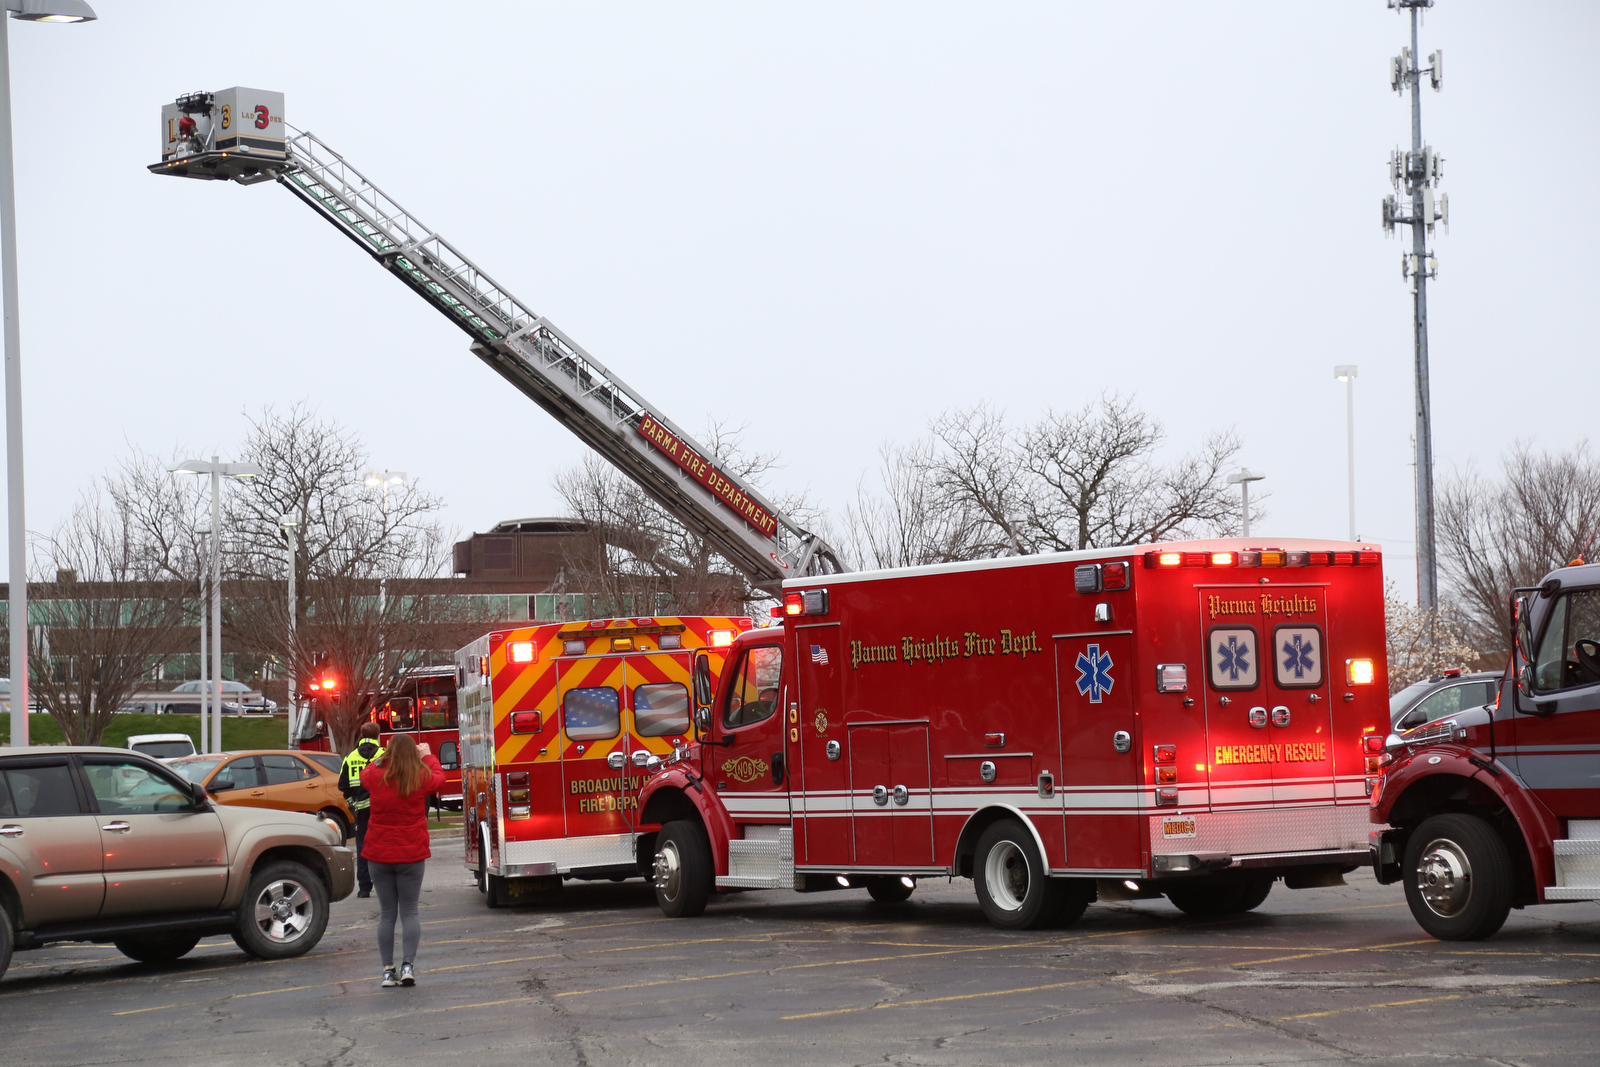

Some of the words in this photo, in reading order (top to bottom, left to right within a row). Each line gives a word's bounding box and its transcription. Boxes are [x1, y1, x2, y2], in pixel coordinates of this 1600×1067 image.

[221, 104, 231, 130] 3
[241, 111, 255, 120] LAD
[255, 104, 270, 130] 3
[269, 116, 283, 124] DER
[642, 418, 678, 456] PARMA
[680, 450, 707, 478] FIRE
[707, 472, 775, 533] DEPARTMENT
[1208, 594, 1256, 620] Parma
[1260, 593, 1317, 619] Heights
[850, 640, 897, 670] Parma
[901, 633, 959, 667] Heights
[962, 631, 996, 658] Fire
[1000, 629, 1042, 660] Dept.
[1215, 744, 1281, 765] EMERGENCY
[1284, 742, 1326, 763] RESCUE
[571, 775, 640, 794] BROADVIEW
[579, 797, 605, 814] FIRE
[608, 795, 640, 812] DEPA
